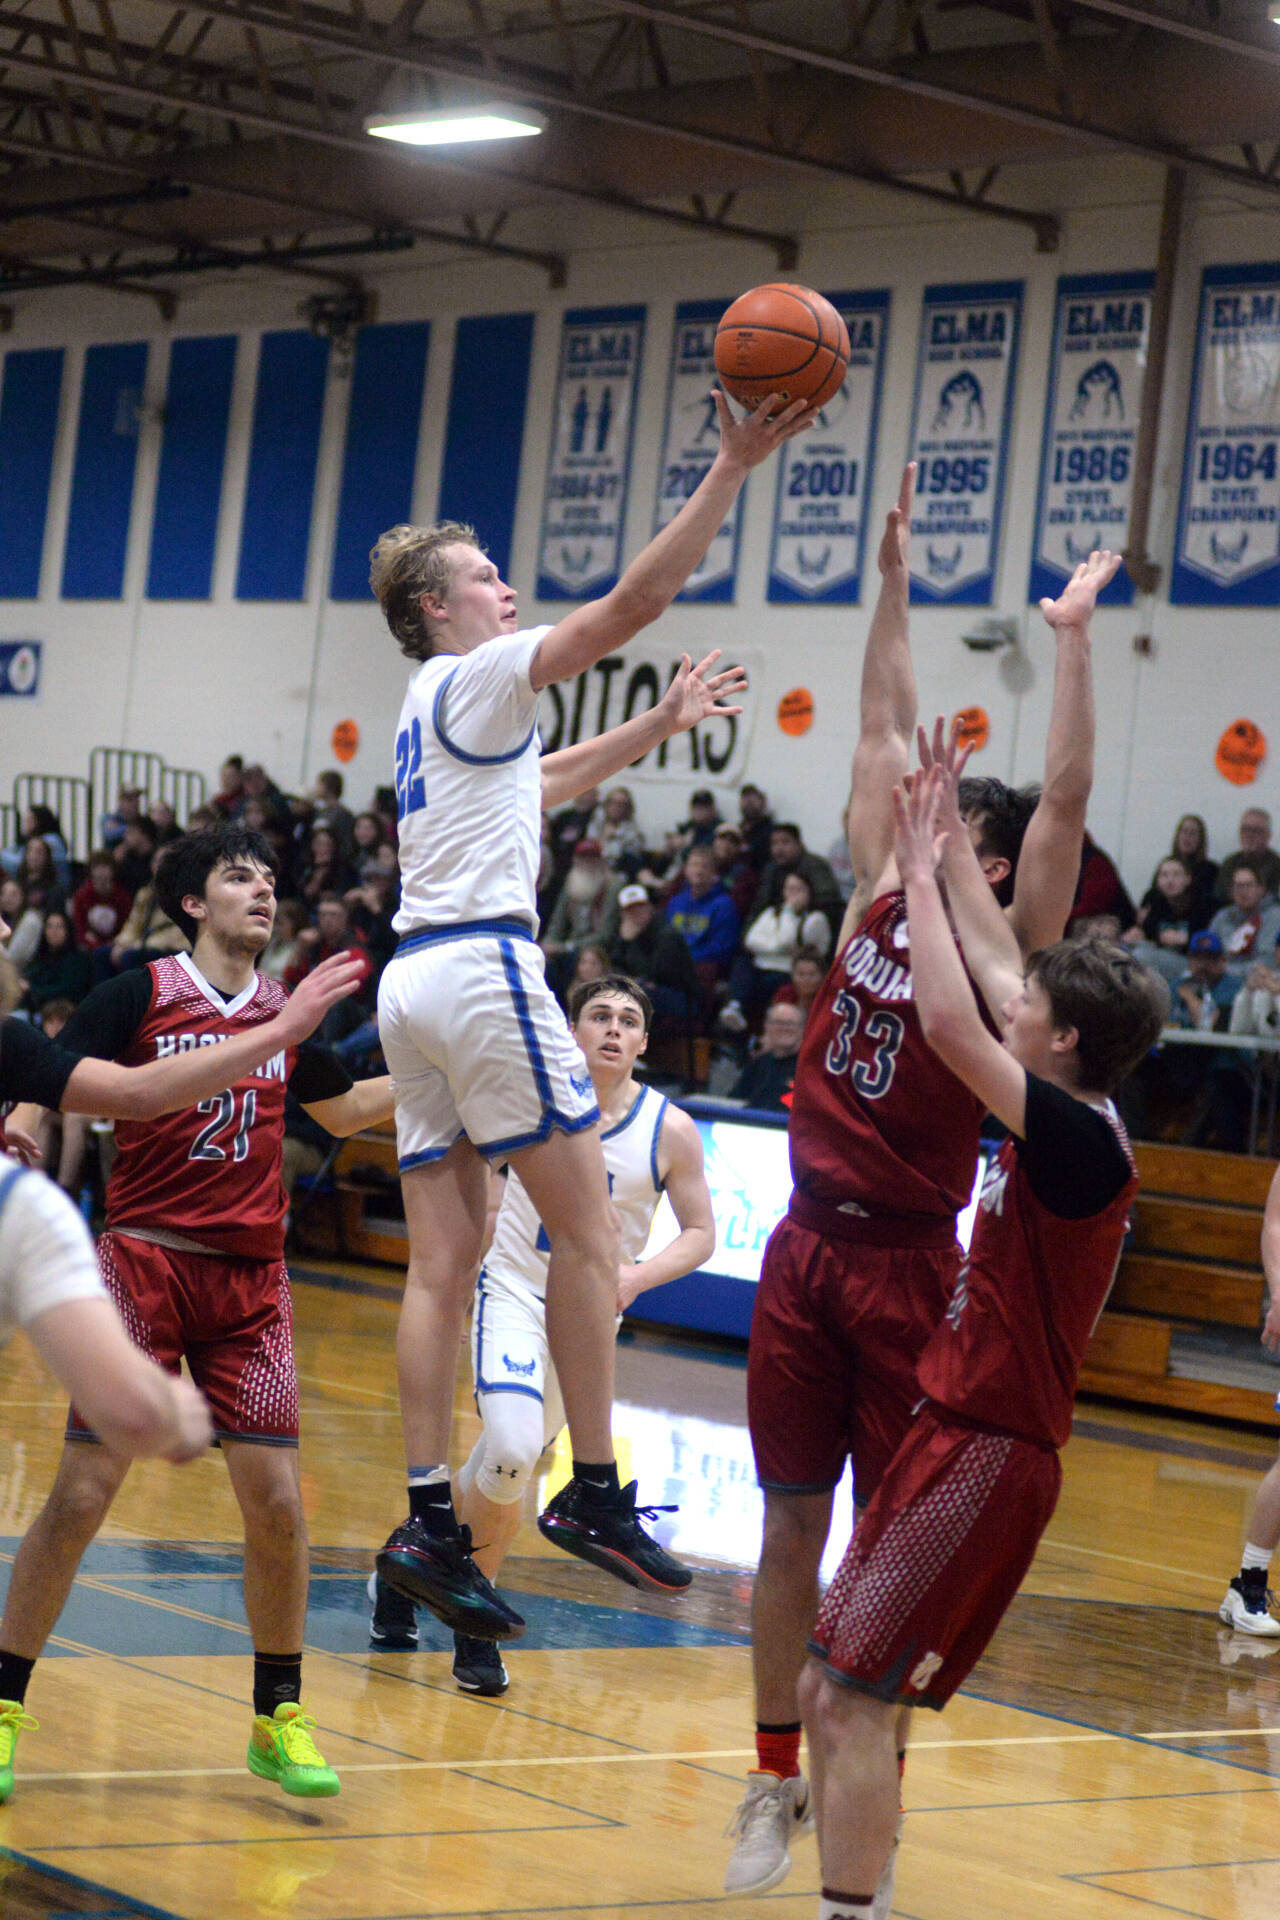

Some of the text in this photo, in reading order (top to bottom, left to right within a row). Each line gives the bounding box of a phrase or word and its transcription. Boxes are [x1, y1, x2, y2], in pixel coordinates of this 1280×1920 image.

[931, 310, 1006, 344] ELMA
[1067, 302, 1144, 335] ELMA
[1213, 295, 1280, 328] ELM
[788, 461, 858, 496] 2001
[916, 457, 989, 493] 1995
[1053, 446, 1131, 483] 1986
[1198, 442, 1277, 480] 1964
[396, 716, 427, 822] 22
[826, 989, 905, 1100] 33
[188, 1088, 257, 1162] 21
